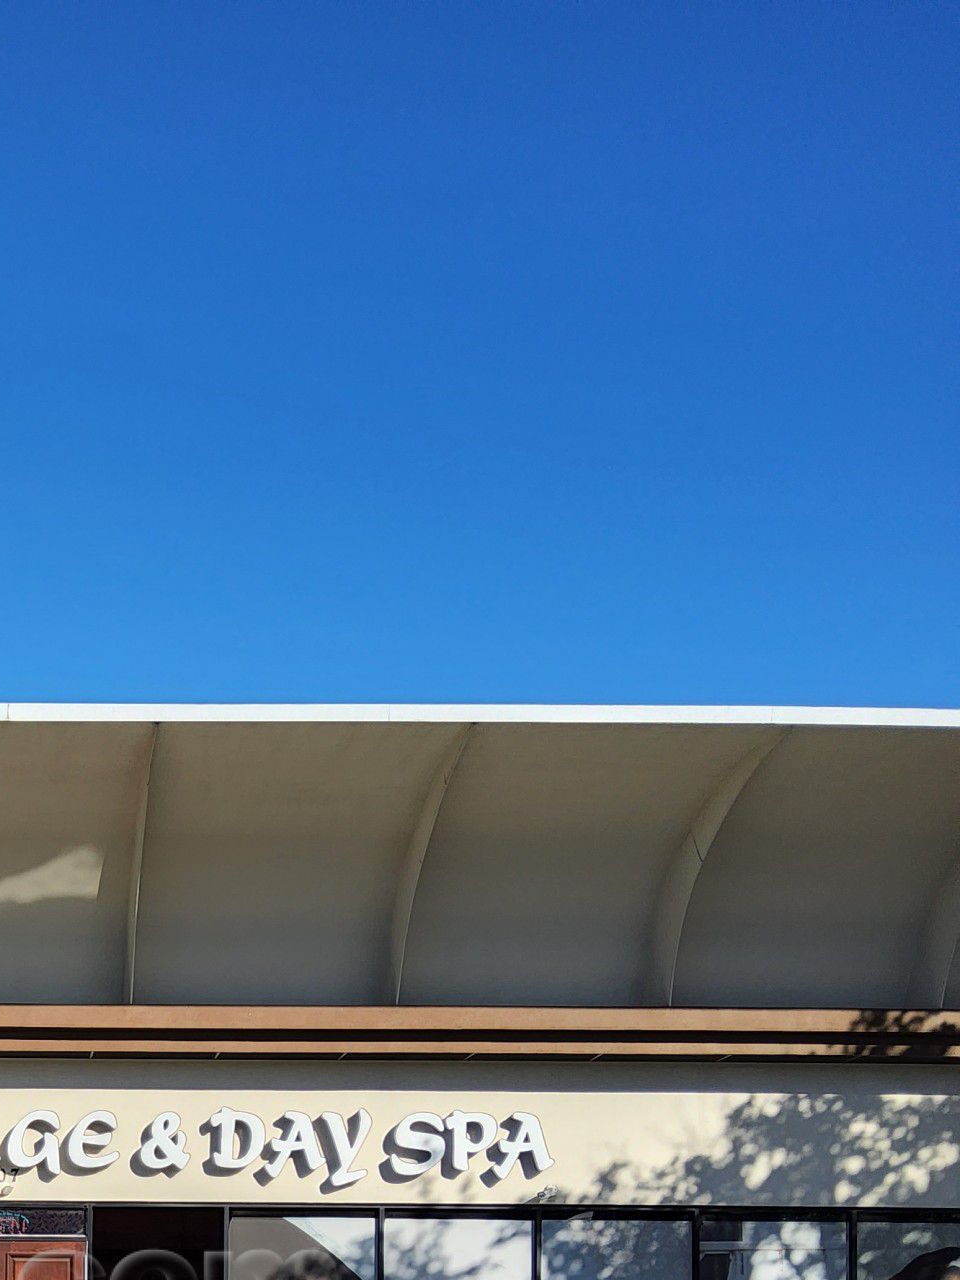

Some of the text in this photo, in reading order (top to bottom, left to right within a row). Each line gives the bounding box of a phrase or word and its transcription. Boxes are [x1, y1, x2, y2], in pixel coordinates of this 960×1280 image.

[129, 1111, 191, 1179] &
[199, 1107, 373, 1196] DAY
[378, 1109, 555, 1190] SPA
